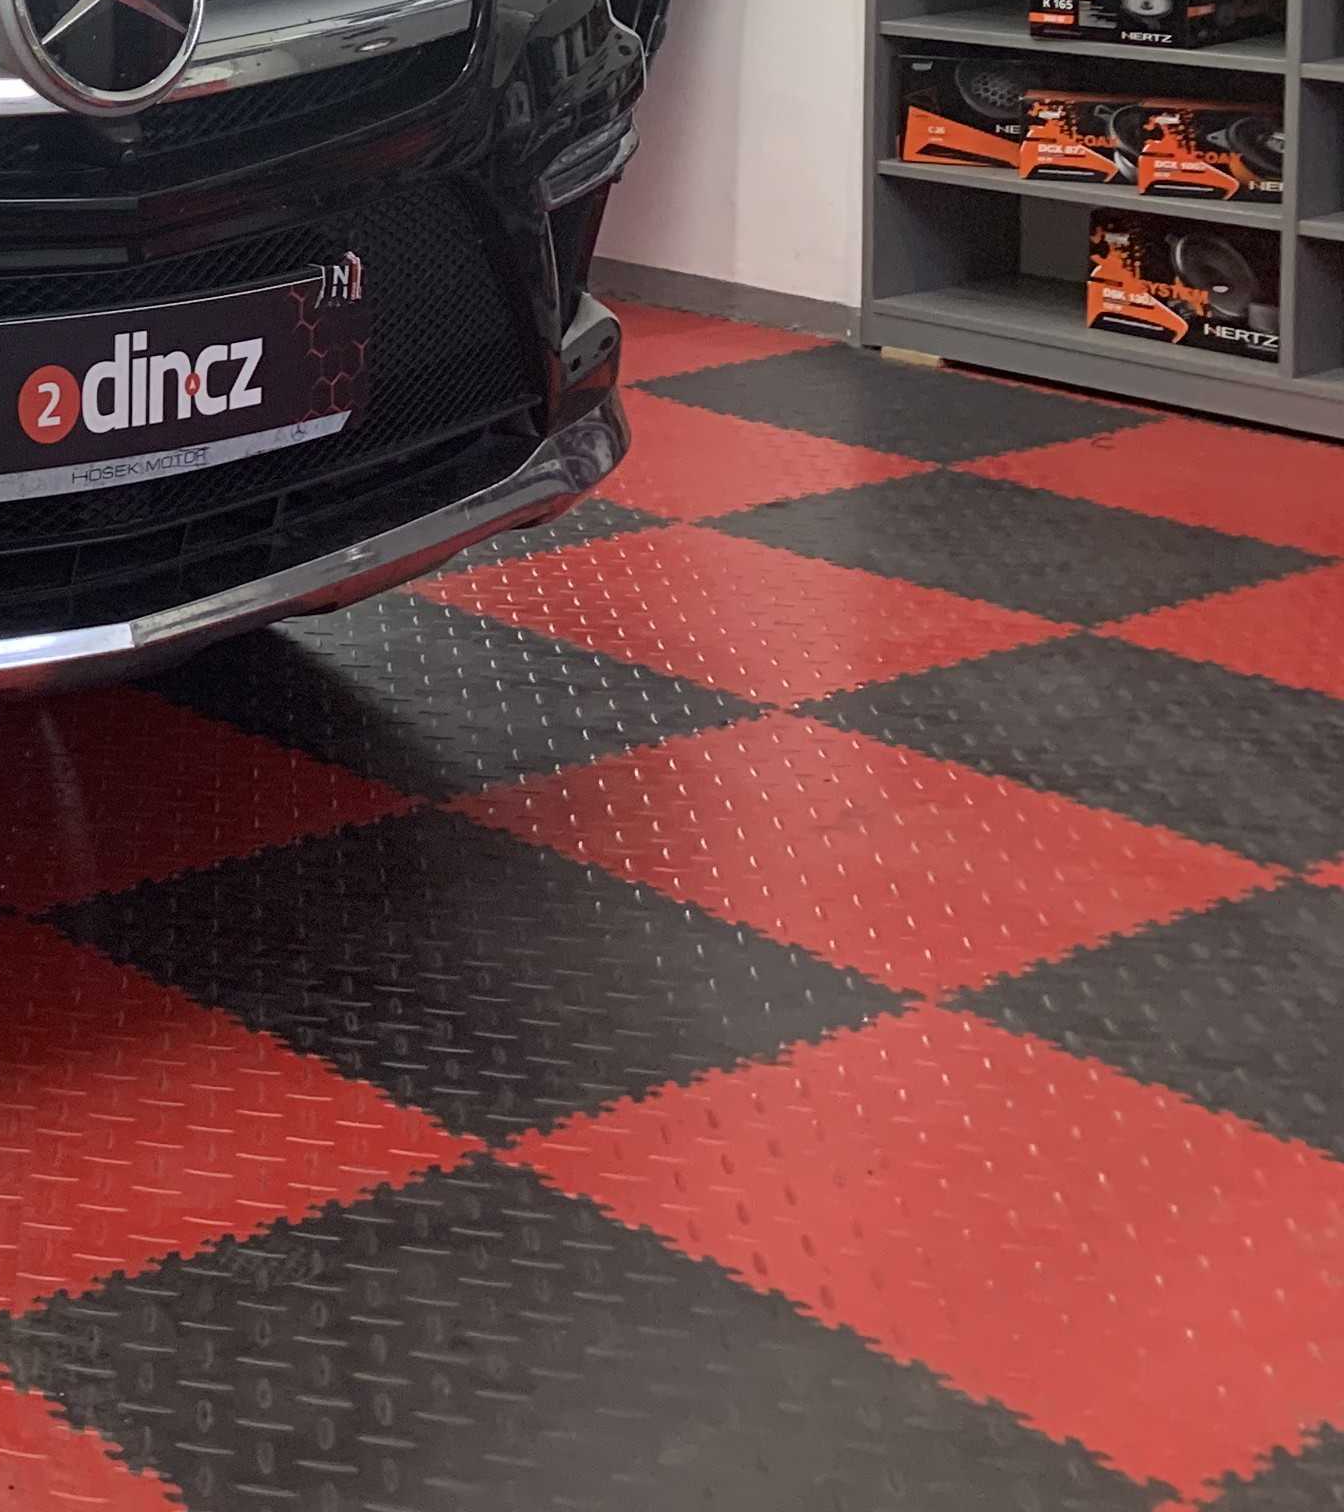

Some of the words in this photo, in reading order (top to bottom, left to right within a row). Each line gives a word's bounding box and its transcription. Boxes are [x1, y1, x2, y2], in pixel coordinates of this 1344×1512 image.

[1053, 0, 1073, 9] 165
[1121, 31, 1173, 44] HERTZ
[1204, 324, 1279, 348] HERTZ
